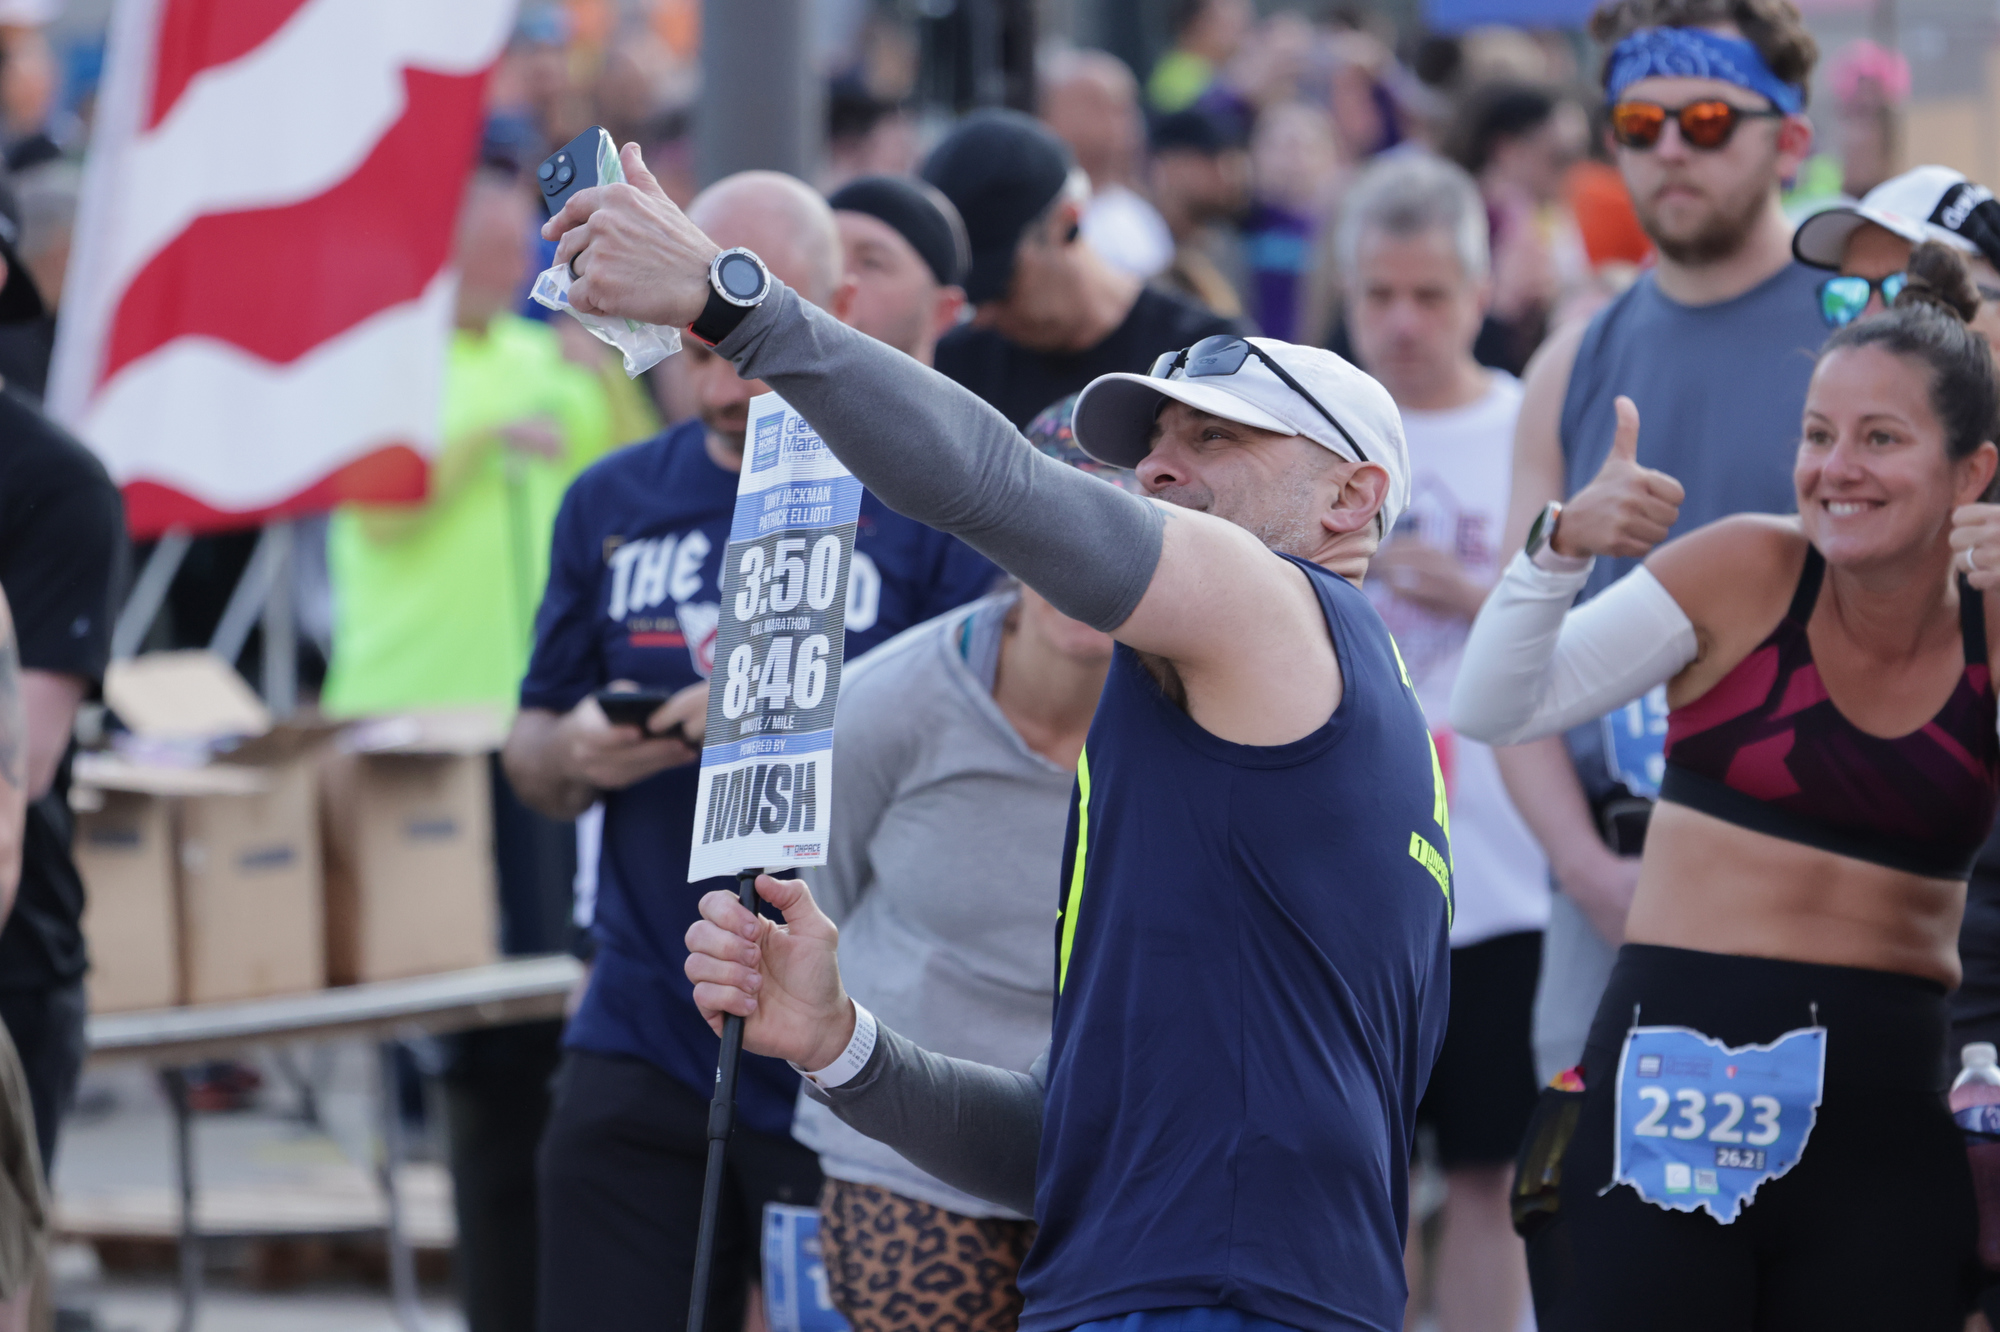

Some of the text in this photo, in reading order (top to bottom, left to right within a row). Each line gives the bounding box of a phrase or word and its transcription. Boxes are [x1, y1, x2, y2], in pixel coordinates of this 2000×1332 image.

[781, 486, 831, 505] JACKMAN
[759, 505, 832, 532] PATRICK ELLIOTT
[607, 529, 711, 622] THE
[734, 534, 841, 621] 3:50
[764, 616, 811, 632] MARATHON
[722, 634, 829, 719] 8:46
[740, 717, 763, 735] MINUTE
[772, 715, 795, 729] MILE
[740, 739, 787, 756] POWERED BY
[702, 761, 816, 844] MUSH
[1634, 1085, 1781, 1146] 2323
[1717, 1148, 1755, 1168] 26.2
